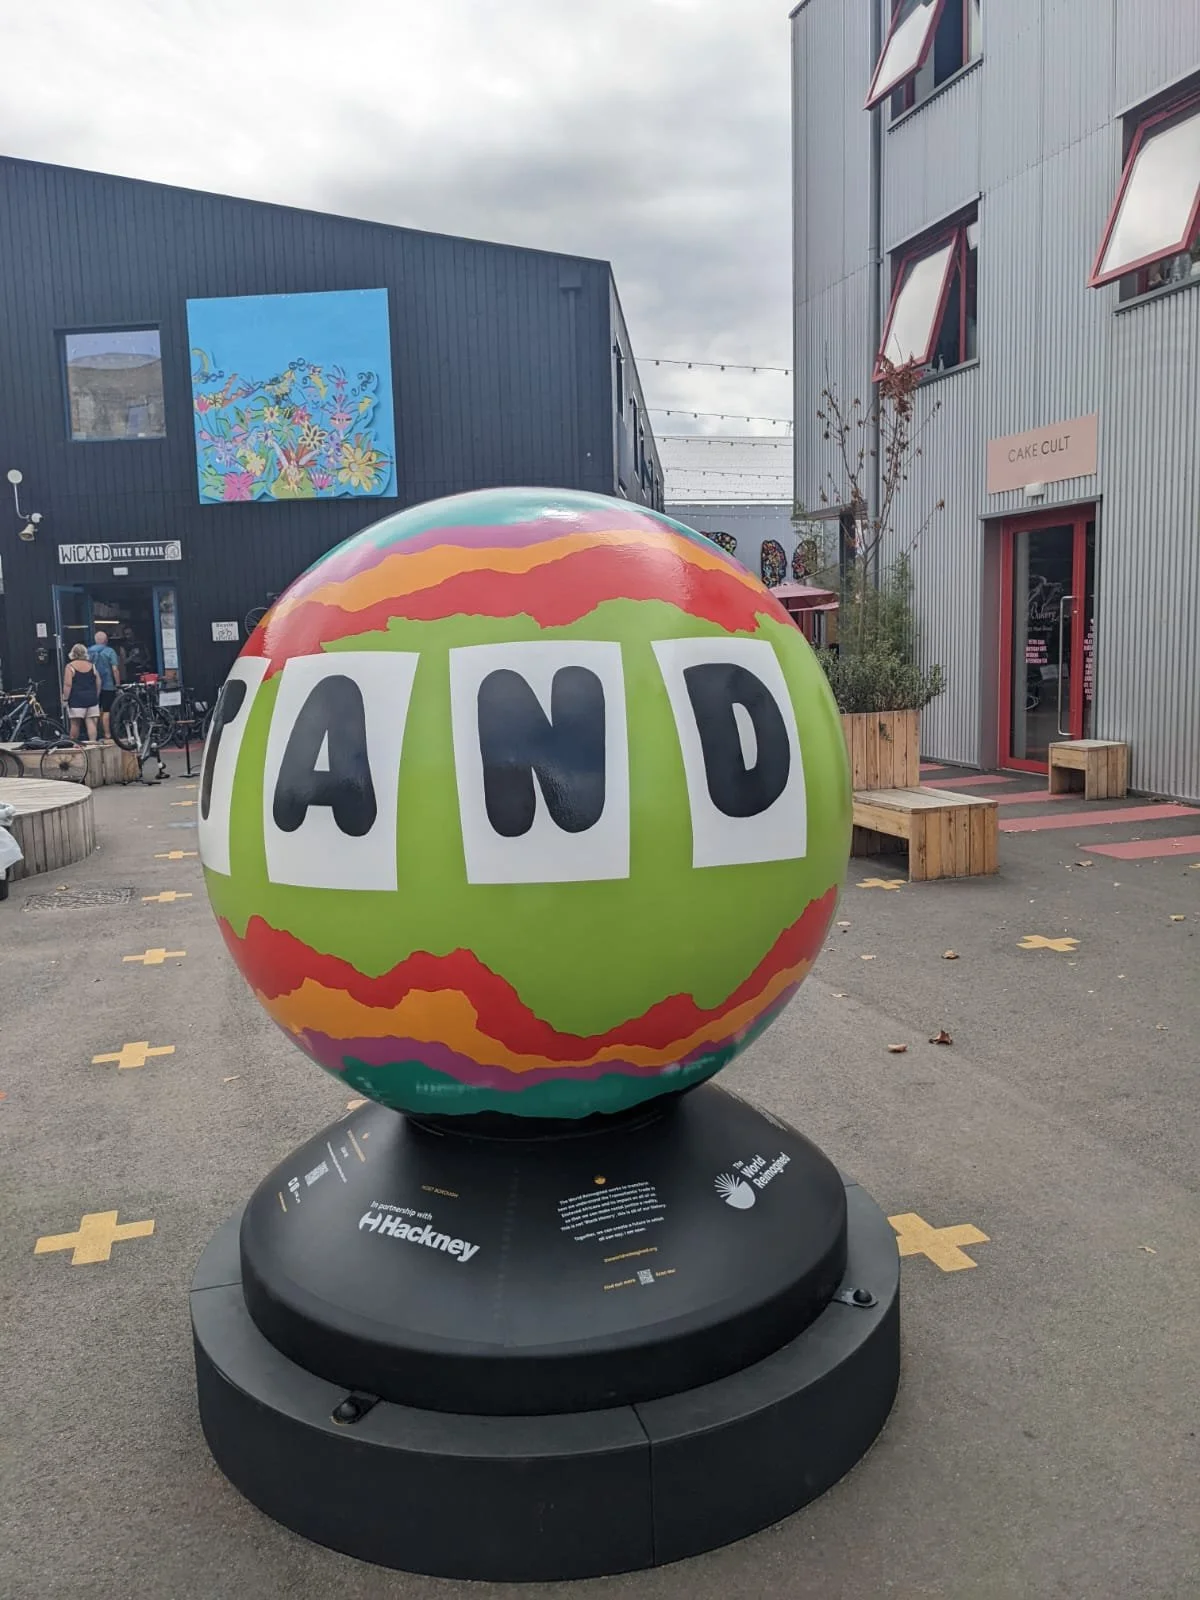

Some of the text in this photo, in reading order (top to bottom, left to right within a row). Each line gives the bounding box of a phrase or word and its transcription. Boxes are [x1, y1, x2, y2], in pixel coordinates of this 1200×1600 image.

[1008, 435, 1071, 463] CAKE CULT
[113, 549, 132, 558] BIKE
[135, 546, 165, 557] REPAIR
[740, 1154, 767, 1178] World
[753, 1151, 791, 1189] Reimagined
[370, 1200, 433, 1221] In partnership with
[378, 1214, 480, 1262] Hackney
